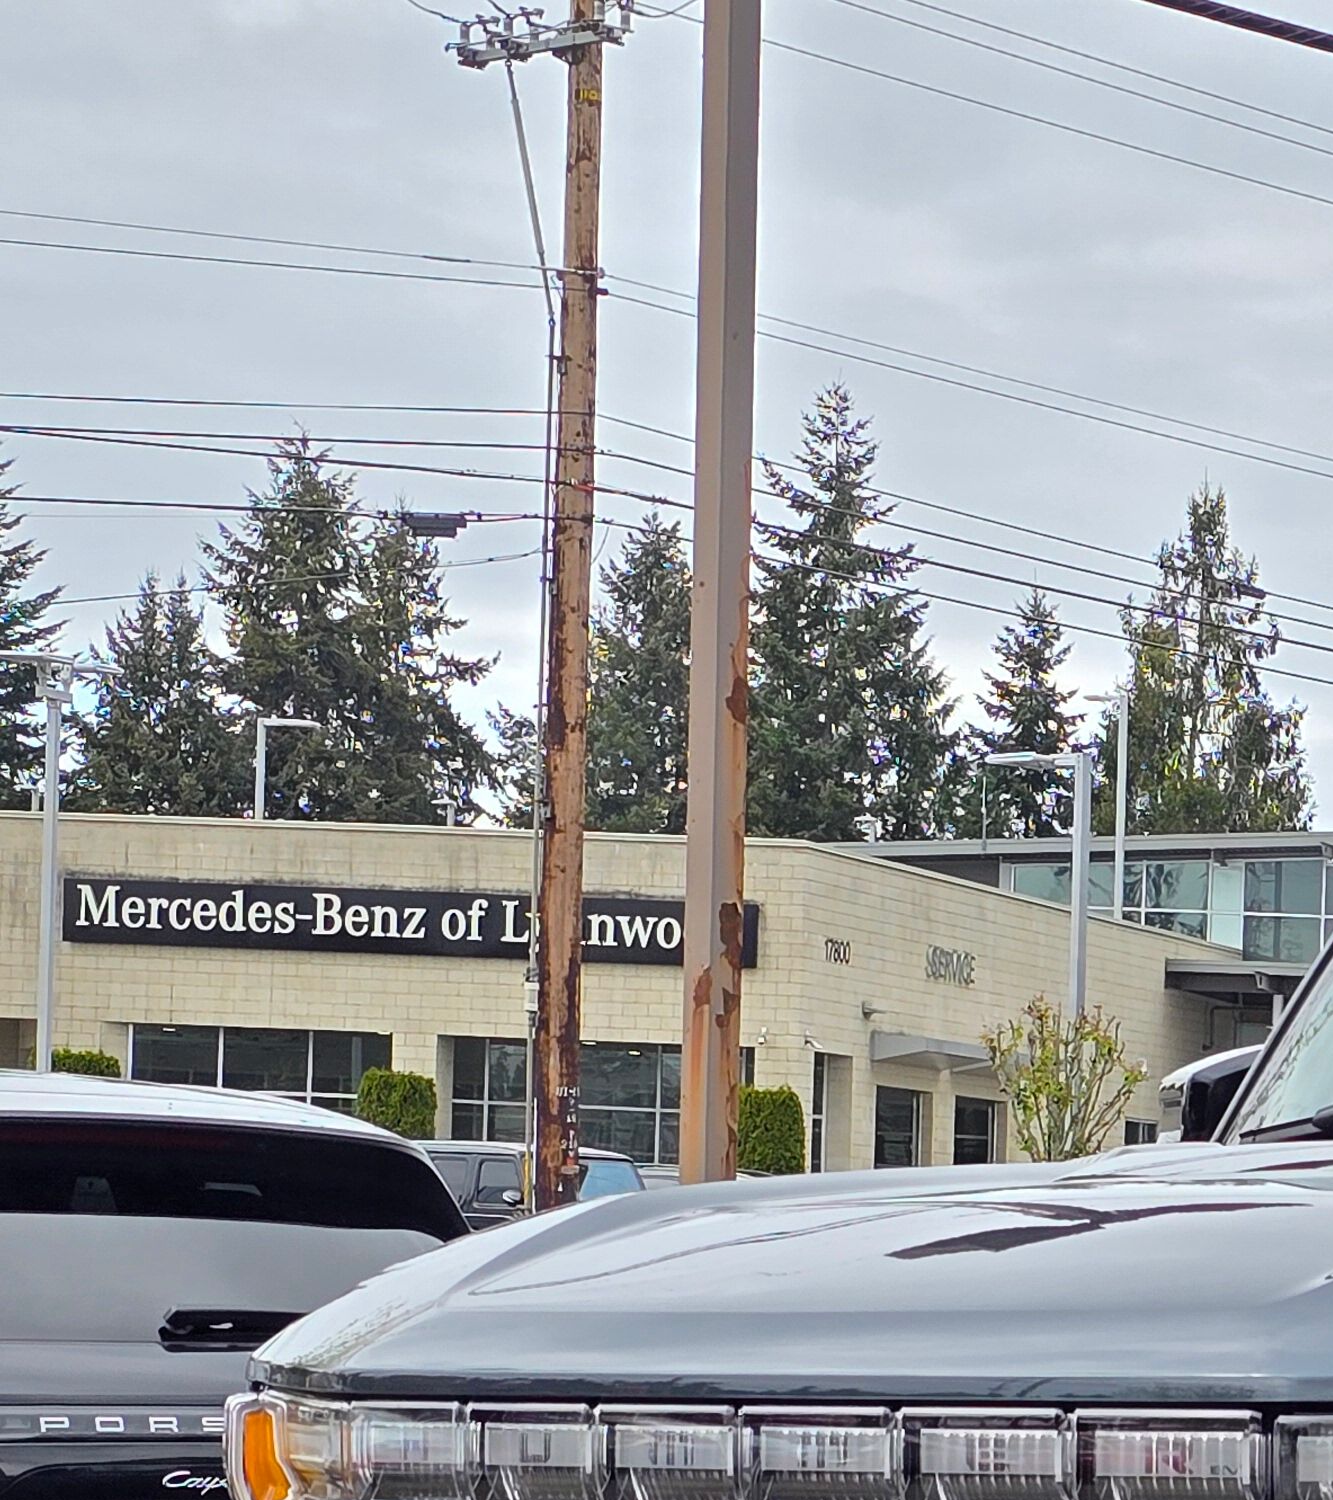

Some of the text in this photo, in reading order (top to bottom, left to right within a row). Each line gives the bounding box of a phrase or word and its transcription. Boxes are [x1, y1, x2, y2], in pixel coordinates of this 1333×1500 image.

[75, 884, 684, 953] Mercedes-Benz of Lnwo
[825, 938, 850, 965] 17800
[925, 945, 976, 985] SERVICE
[40, 1416, 225, 1433] PORS
